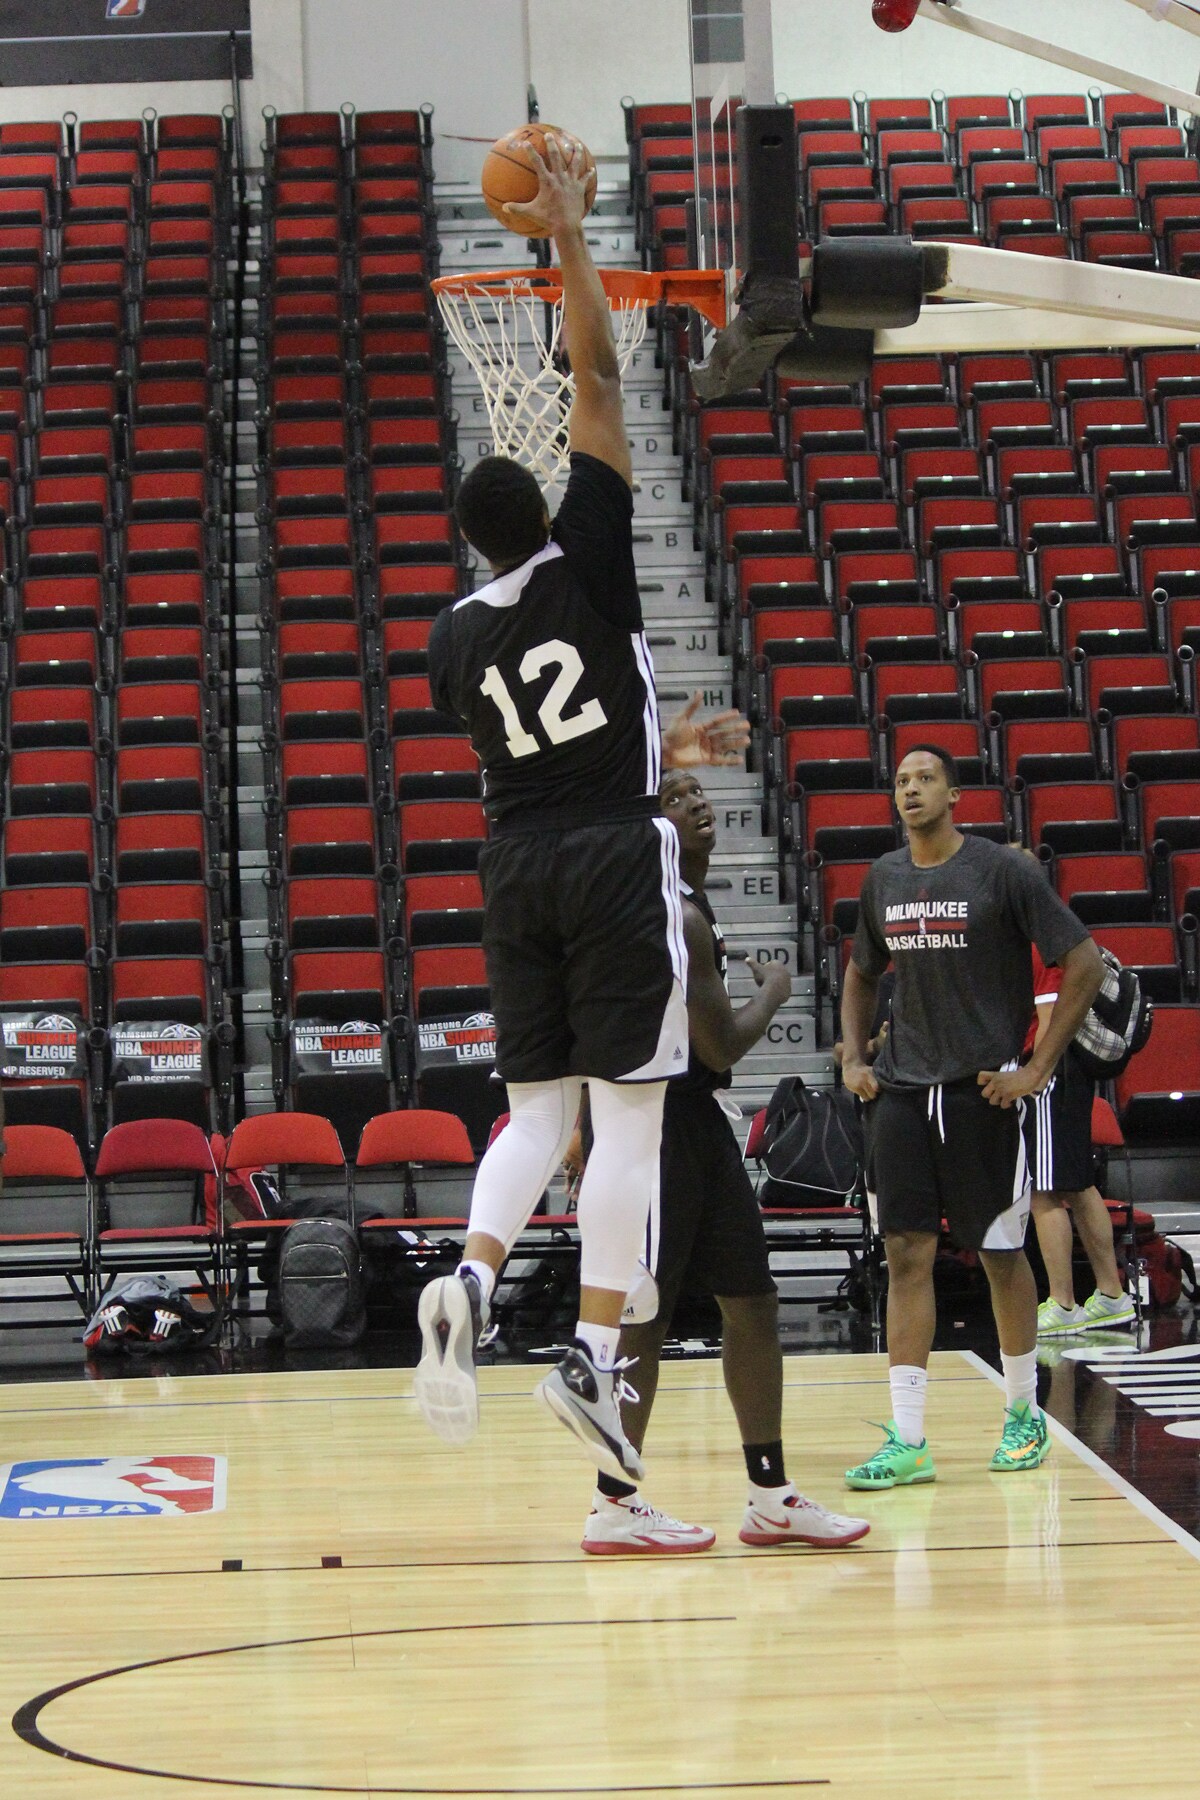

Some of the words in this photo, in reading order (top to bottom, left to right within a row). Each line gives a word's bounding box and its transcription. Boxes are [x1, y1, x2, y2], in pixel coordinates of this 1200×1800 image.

[453, 206, 464, 219] K
[460, 240, 469, 253] J
[612, 238, 620, 250] J
[632, 353, 642, 367] F
[473, 398, 484, 413] E
[641, 395, 651, 408] E
[478, 441, 490, 457] D
[645, 438, 658, 452] D
[651, 484, 665, 500] C
[665, 532, 678, 548] B
[677, 582, 691, 598] A
[685, 635, 707, 651] JJ
[479, 638, 609, 759] 12
[725, 810, 753, 828] FF
[743, 877, 774, 895] EE
[885, 901, 968, 922] MILWAUKEE
[885, 933, 968, 951] BASKETBALL
[756, 947, 790, 966] DD
[295, 1025, 338, 1034] SAMSUNG
[418, 1020, 461, 1032] SAMSUNG
[766, 1023, 803, 1044] CC
[115, 1030, 159, 1039] SAMSUNG
[295, 1036, 323, 1051] NBA
[322, 1033, 382, 1051] SUMMER
[418, 1032, 447, 1049] NBA
[445, 1027, 497, 1046] SUMME
[25, 1045, 77, 1059] LEAGUE
[115, 1041, 143, 1055] NBA
[331, 1048, 382, 1064] LEAGUE
[455, 1041, 497, 1059] LEAGU
[150, 1054, 202, 1069] LEAGUE
[19, 1066, 66, 1076] RESERVED
[18, 1503, 147, 1517] NBA
